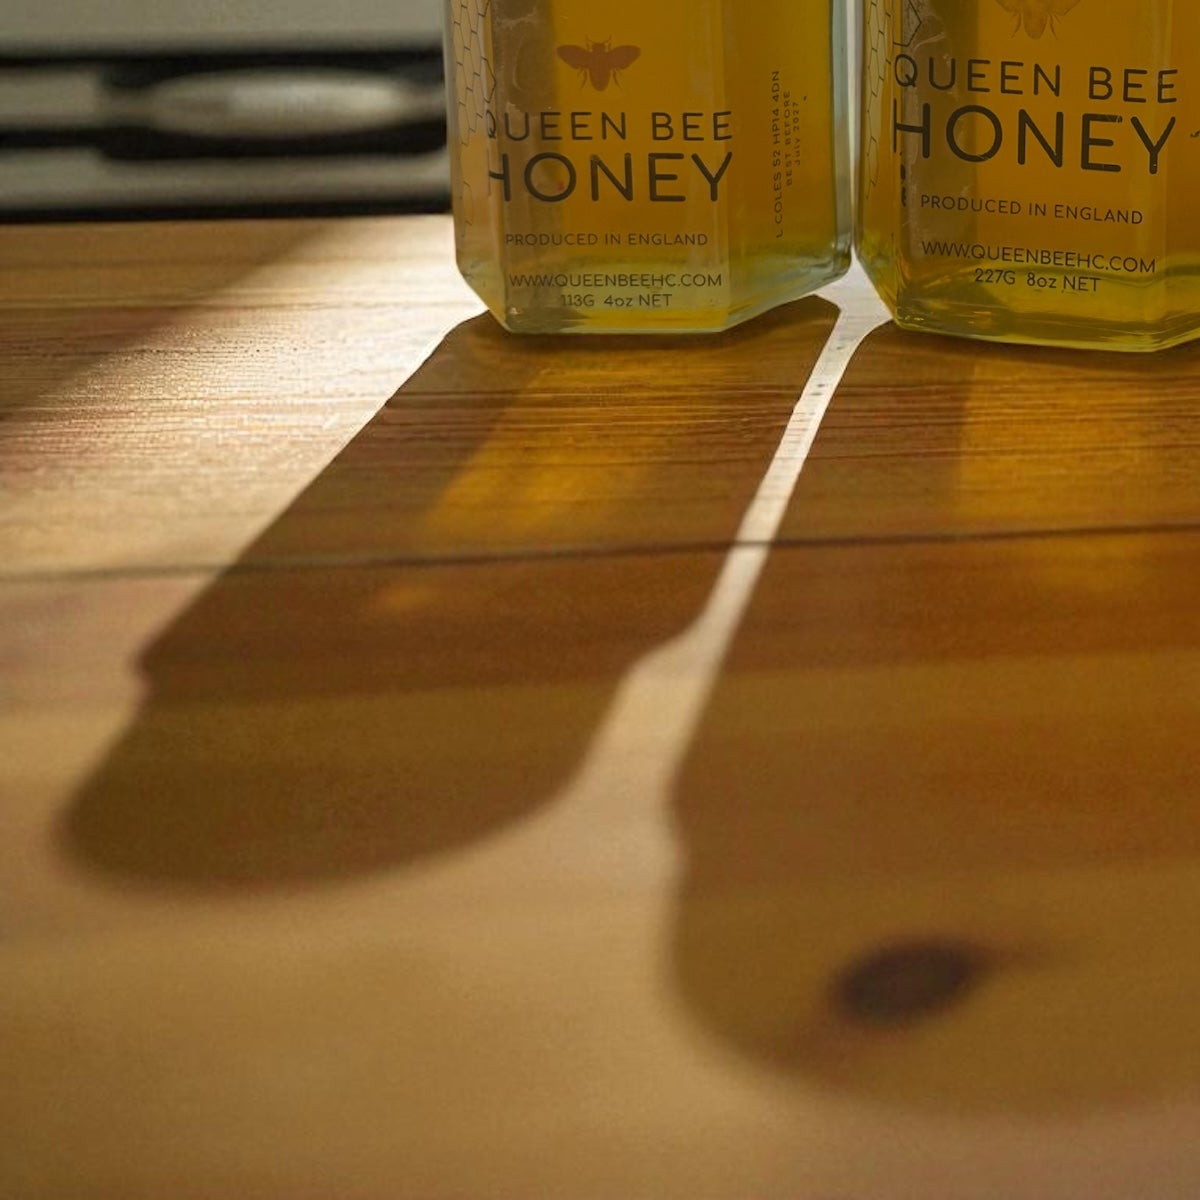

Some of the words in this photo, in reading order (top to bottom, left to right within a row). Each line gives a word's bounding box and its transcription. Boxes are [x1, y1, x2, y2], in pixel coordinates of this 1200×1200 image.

[771, 70, 780, 102] 4DN
[893, 54, 1061, 98] QUEEN
[1089, 67, 1178, 104] BEE
[652, 111, 733, 141] BEE
[893, 98, 1177, 176] HONEY
[487, 151, 733, 203] HONEY
[773, 171, 783, 224] COLES
[920, 194, 1021, 215] PRODUCED
[1028, 202, 1046, 217] IN
[1054, 204, 1143, 225] ENGLAND
[505, 233, 598, 246] PRODUCED
[604, 233, 621, 246] IN
[628, 233, 708, 246] ENGLAND
[921, 240, 1156, 273] WWW.QUEENBEEHC.COM
[509, 273, 722, 288] WWW.QUEENBEEHC.COM
[974, 268, 1016, 285] 227G
[1026, 272, 1057, 289] 8oz
[1063, 275, 1101, 292] NET
[561, 294, 595, 307] 113G
[603, 294, 632, 307] 4oz
[639, 293, 673, 307] NET
